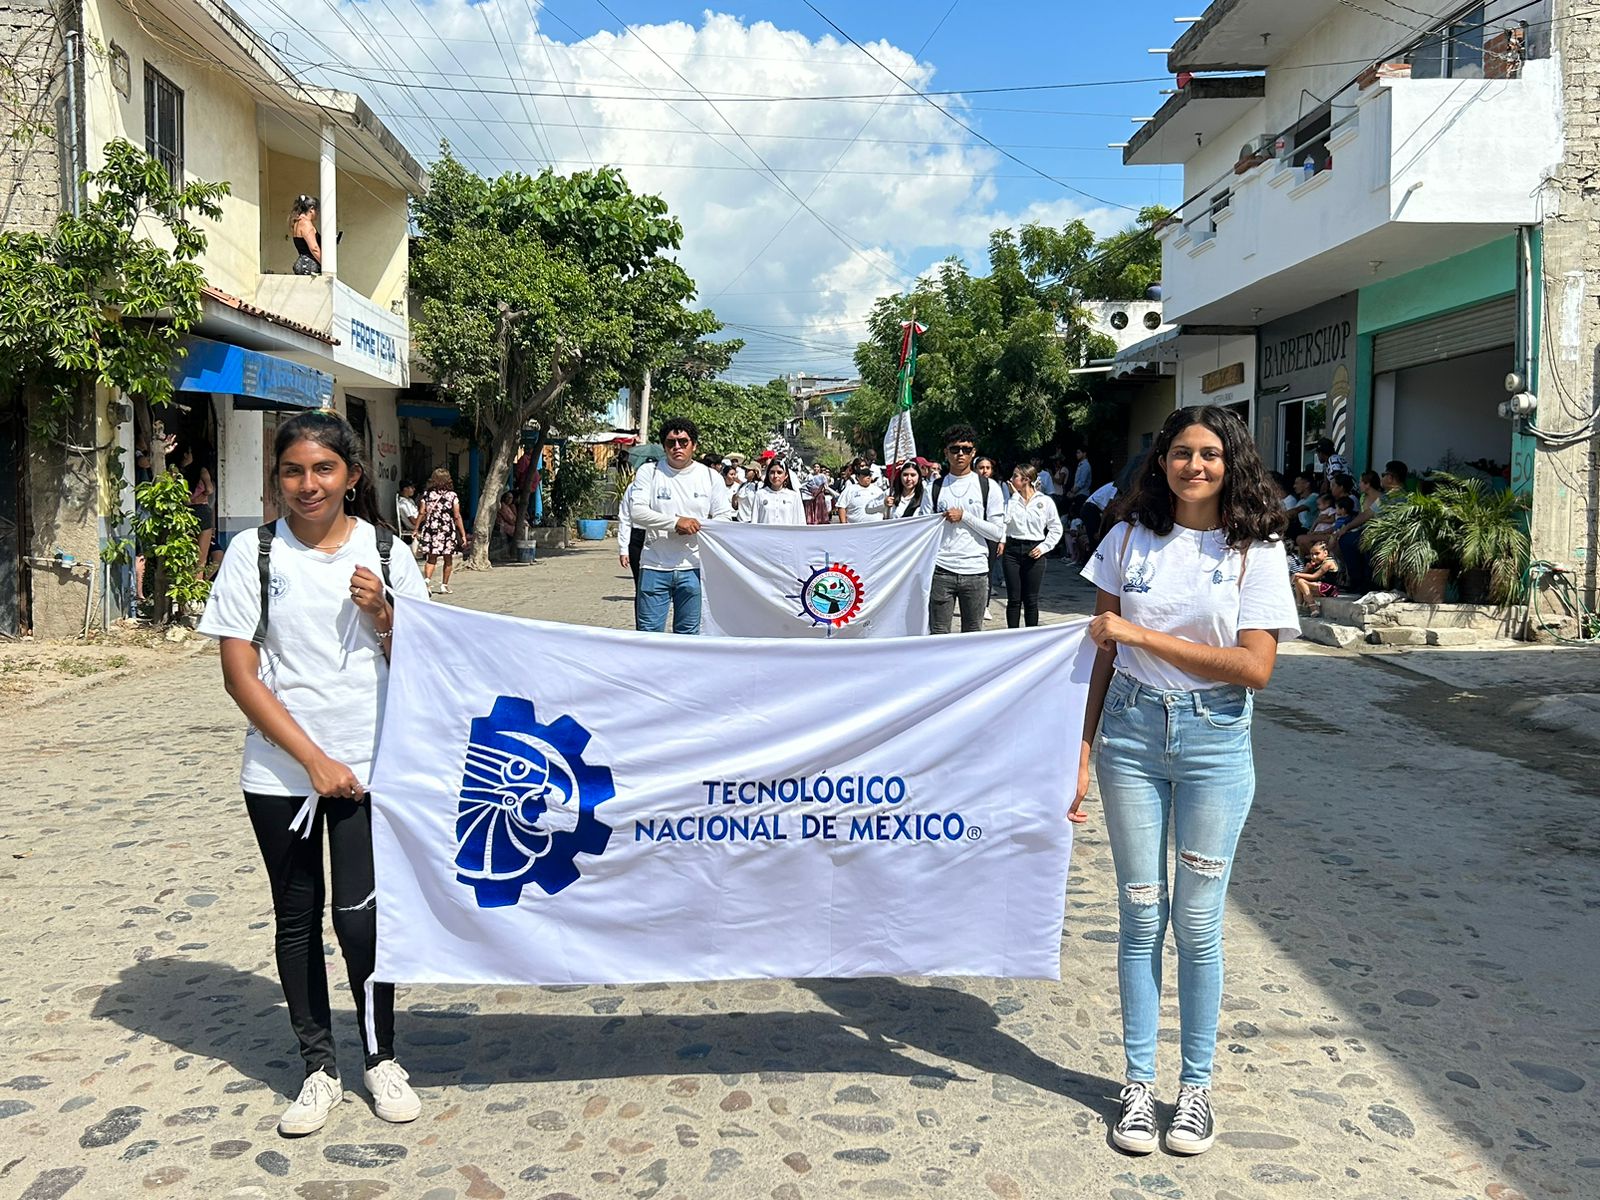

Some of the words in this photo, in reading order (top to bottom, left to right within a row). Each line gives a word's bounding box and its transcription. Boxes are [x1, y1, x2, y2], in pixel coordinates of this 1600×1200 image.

[1264, 320, 1351, 380] BARBERSHOP
[702, 769, 906, 806] TECNOLÓGICO
[634, 814, 788, 842] NACIONAL
[801, 814, 837, 840] DE
